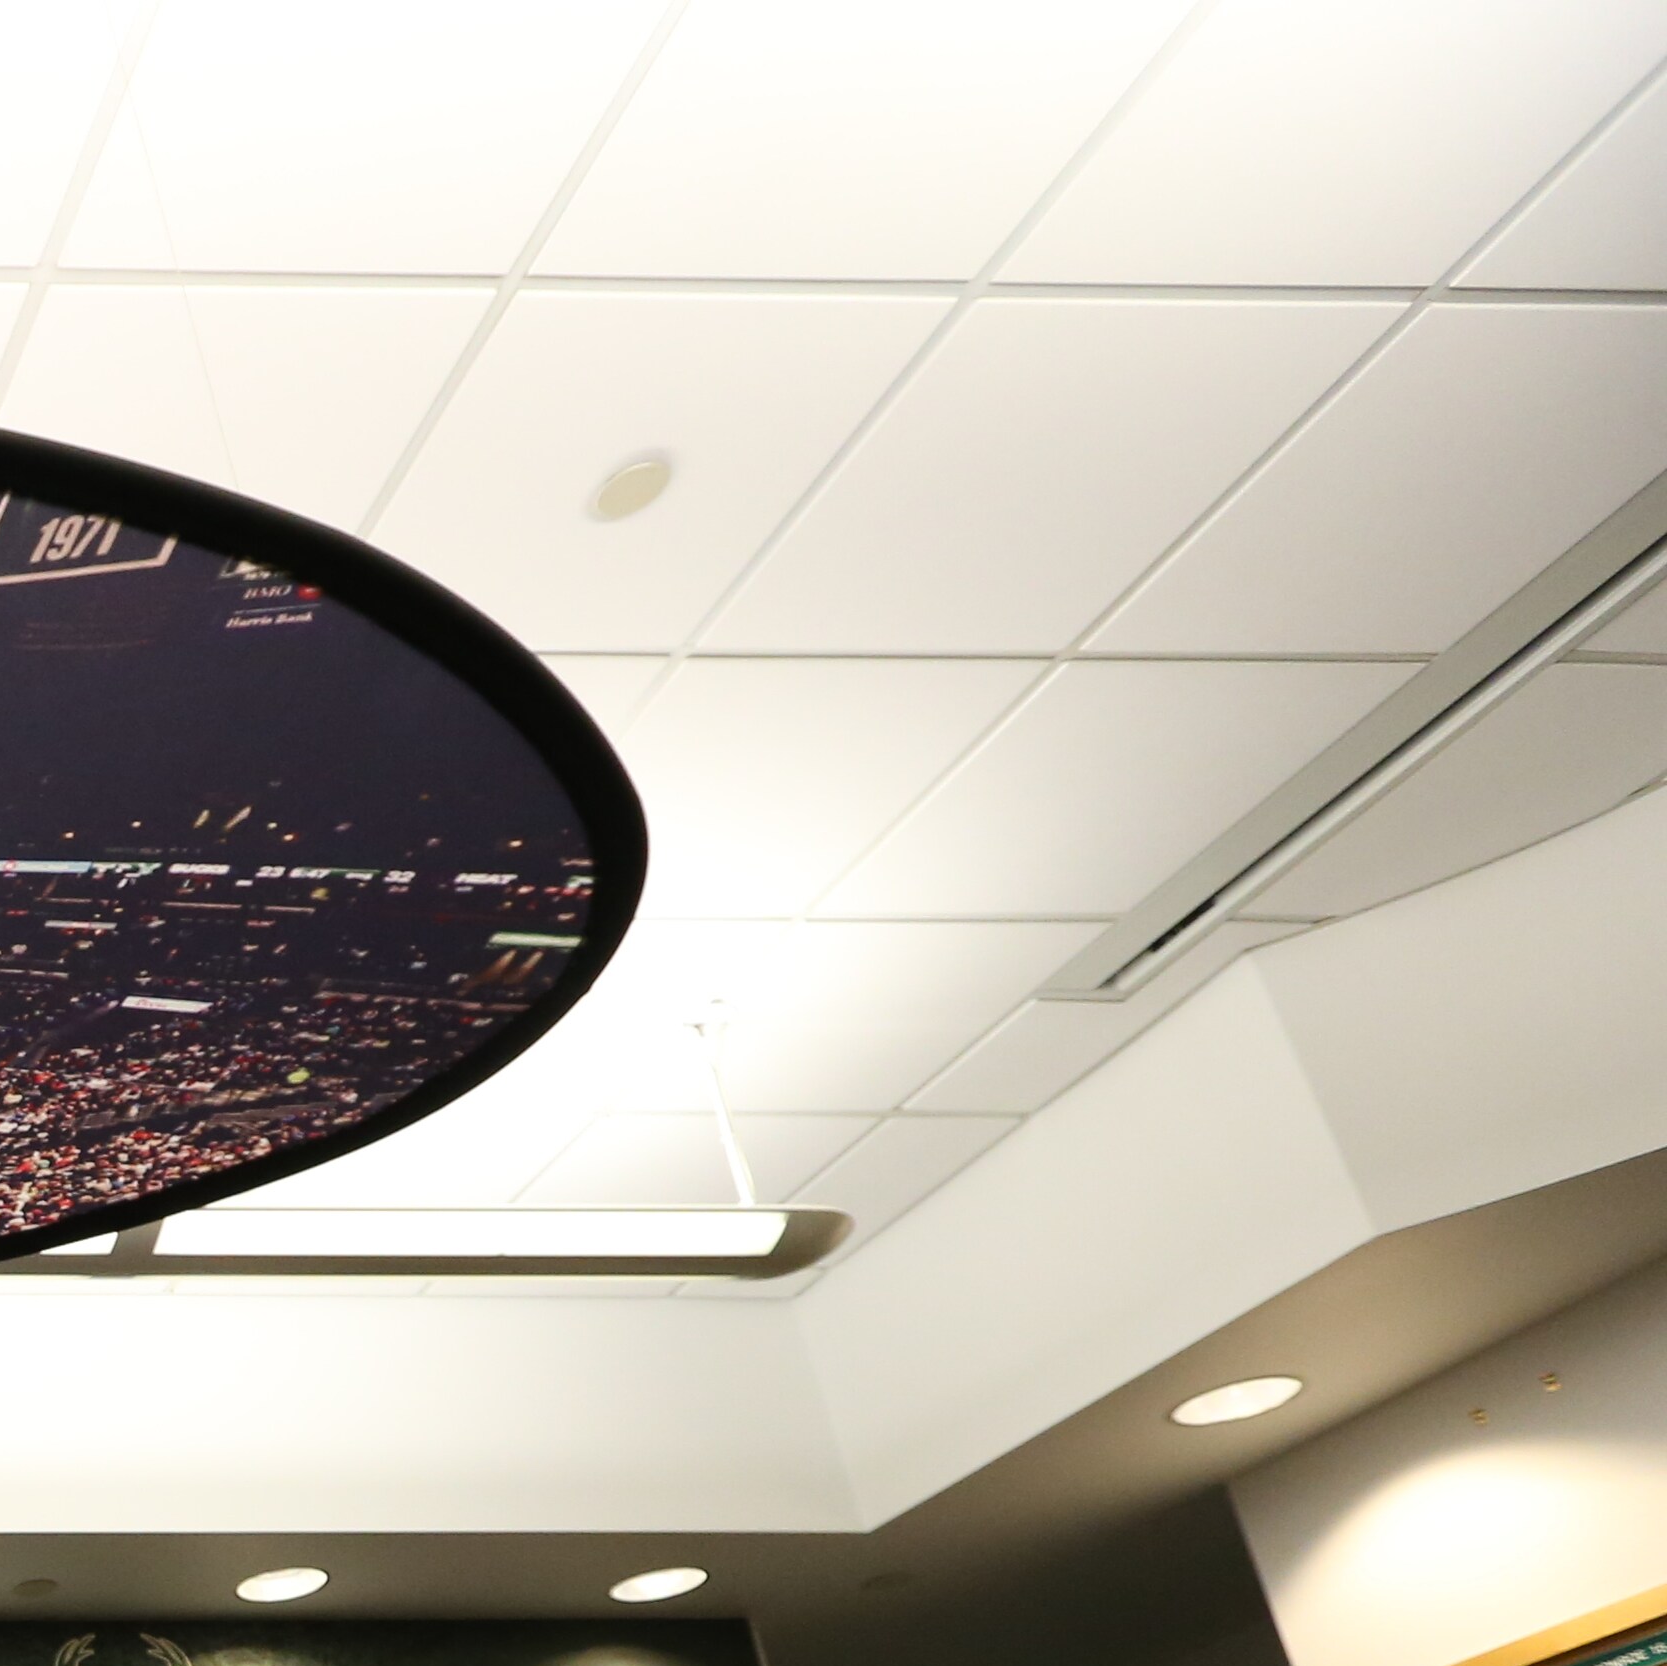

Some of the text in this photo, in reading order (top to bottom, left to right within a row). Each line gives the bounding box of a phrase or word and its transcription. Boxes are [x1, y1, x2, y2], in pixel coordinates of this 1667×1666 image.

[30, 516, 122, 564] 1971
[226, 611, 313, 628] Harris Bank
